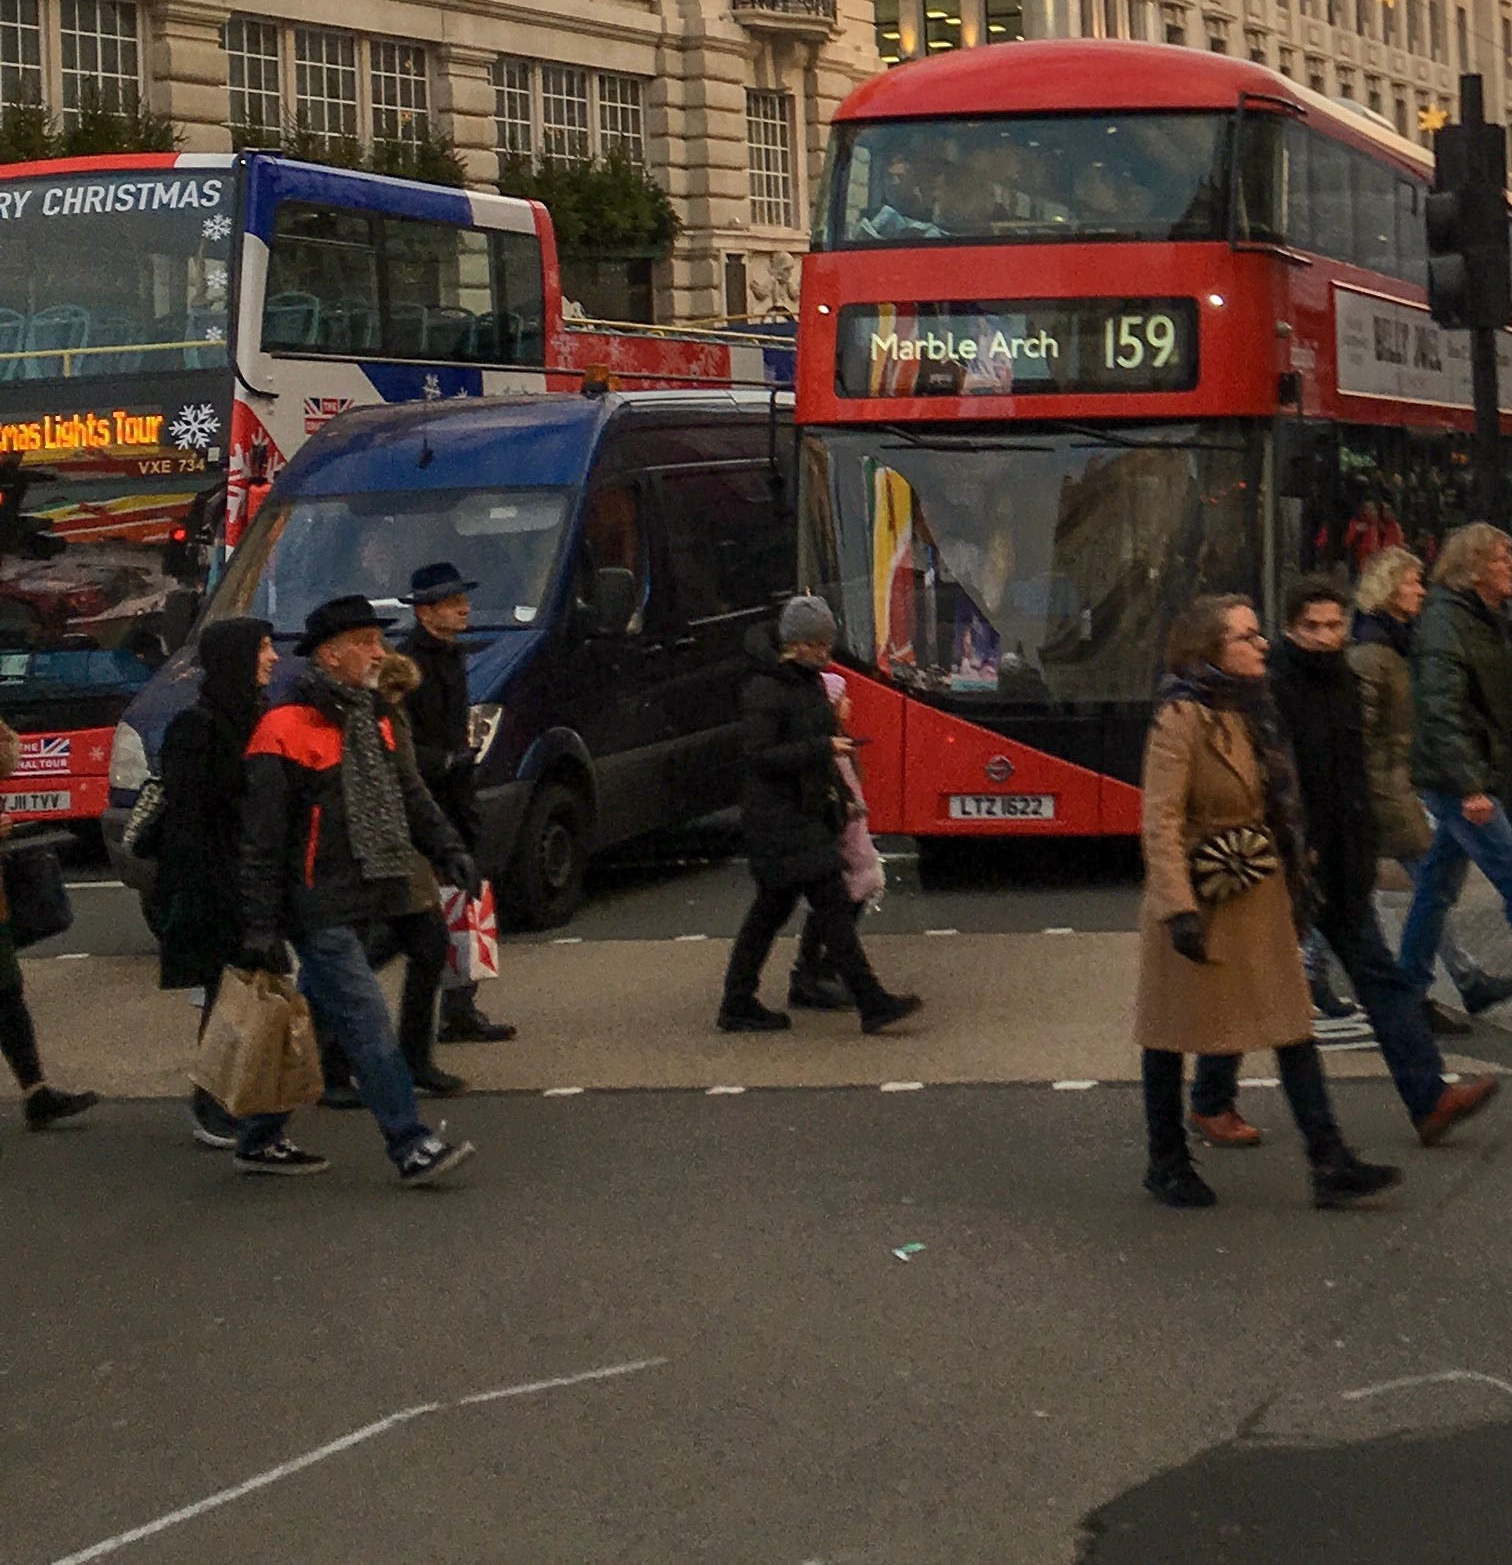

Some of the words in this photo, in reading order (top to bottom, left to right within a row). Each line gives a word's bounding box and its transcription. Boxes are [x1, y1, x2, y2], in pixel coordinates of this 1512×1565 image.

[43, 180, 223, 217] CHRISTMAS
[870, 332, 978, 361] Marble
[989, 331, 1059, 359] Arch
[1105, 314, 1176, 369] 159
[44, 413, 111, 449] Lights
[112, 411, 163, 445] Tour
[138, 460, 171, 474] VXE
[178, 458, 205, 473] 734
[40, 758, 68, 769] TOUR
[961, 797, 996, 816] LTZ
